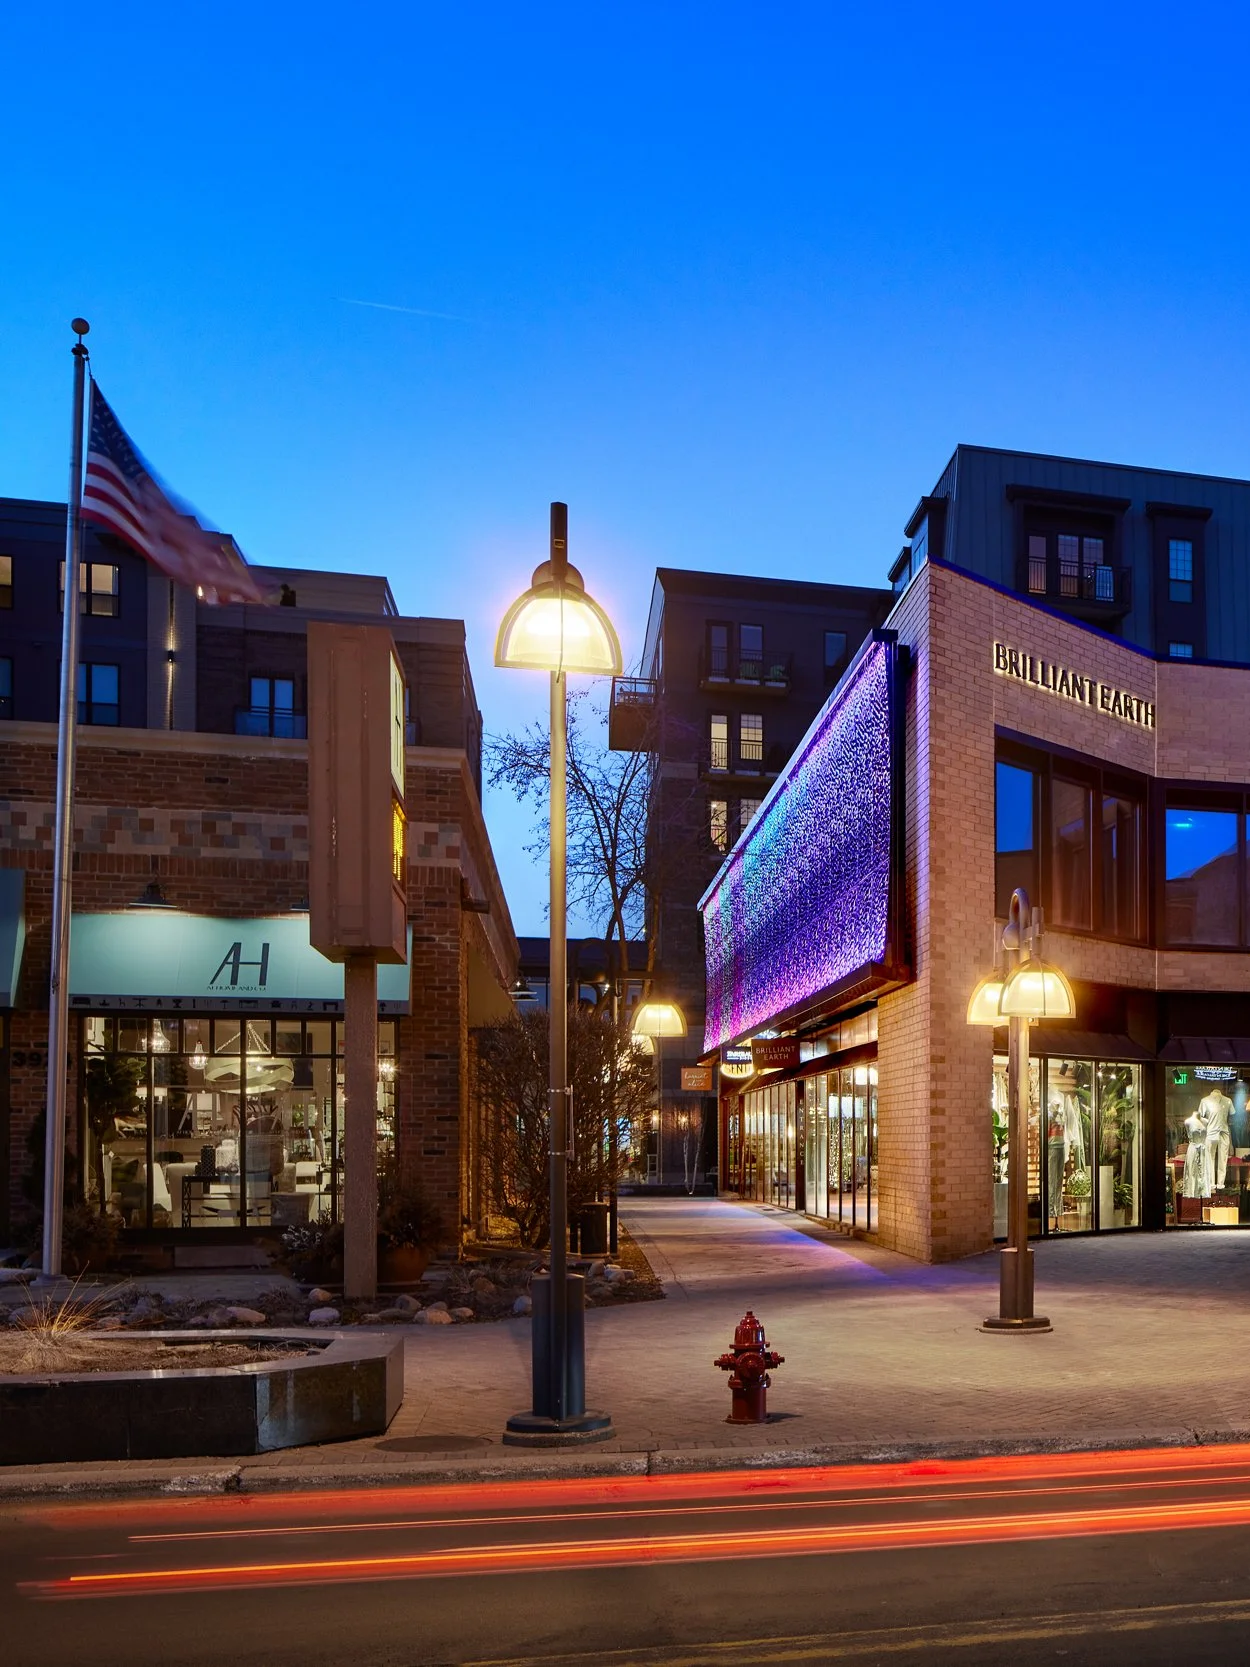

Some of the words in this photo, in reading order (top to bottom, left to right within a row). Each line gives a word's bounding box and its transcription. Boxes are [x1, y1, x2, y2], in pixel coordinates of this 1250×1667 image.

[994, 642, 1097, 706] BRILLIANT
[1099, 684, 1156, 728] EARTH
[209, 942, 270, 986] AH
[755, 1045, 796, 1054] BRILLIANT
[763, 1053, 790, 1061] EARTH
